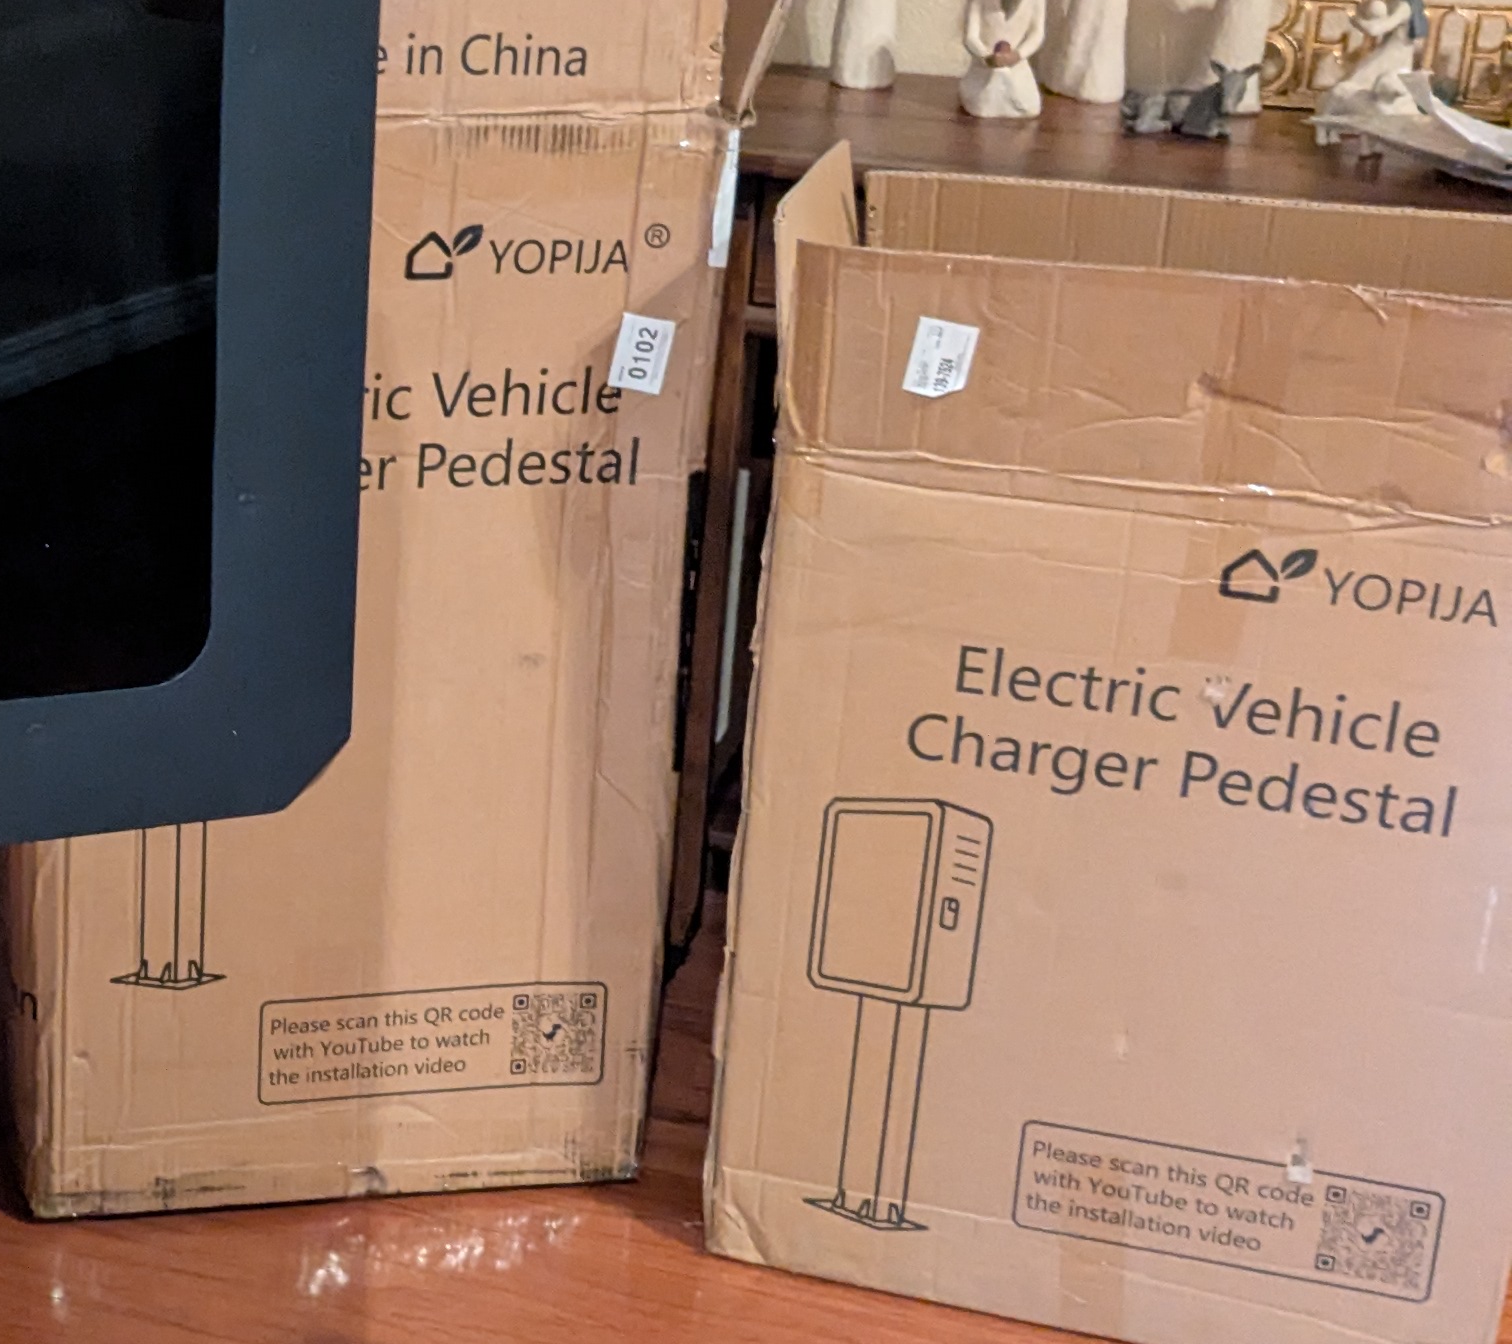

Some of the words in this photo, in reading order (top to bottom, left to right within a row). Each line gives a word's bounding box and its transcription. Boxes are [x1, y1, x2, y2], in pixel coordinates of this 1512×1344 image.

[405, 32, 443, 75] in
[460, 31, 588, 76] China
[488, 238, 628, 275] YOPIJA
[628, 327, 658, 380] 0102
[432, 365, 622, 418] Vehicle
[417, 437, 640, 488] Pedestal
[1322, 567, 1498, 627] YOPIJA
[955, 644, 1180, 722] Electric
[1205, 675, 1440, 757] Vehicle
[906, 713, 1158, 795] Charger
[1180, 750, 1458, 837] Pedestal
[271, 1014, 331, 1035] Please
[336, 1016, 378, 1031] scan
[385, 1009, 419, 1027] this
[424, 1006, 453, 1027] QR
[459, 1003, 505, 1021] code
[273, 1042, 314, 1061] with
[320, 1035, 405, 1057] YouTube
[410, 1035, 429, 1050] to
[436, 1029, 491, 1048] watch
[269, 1068, 299, 1086] the
[306, 1062, 409, 1084] installation
[414, 1058, 466, 1075] video
[1033, 1140, 1101, 1168] Please
[1109, 1158, 1159, 1179] scan
[1168, 1163, 1207, 1186] this
[1214, 1173, 1250, 1196] QR
[1257, 1182, 1314, 1207] code
[1034, 1169, 1080, 1193] with
[1089, 1178, 1187, 1210] YouTube
[1196, 1198, 1218, 1216] to
[1225, 1204, 1294, 1231] watch
[1026, 1193, 1061, 1215] the
[1068, 1200, 1190, 1239] installation
[1198, 1227, 1261, 1251] video
